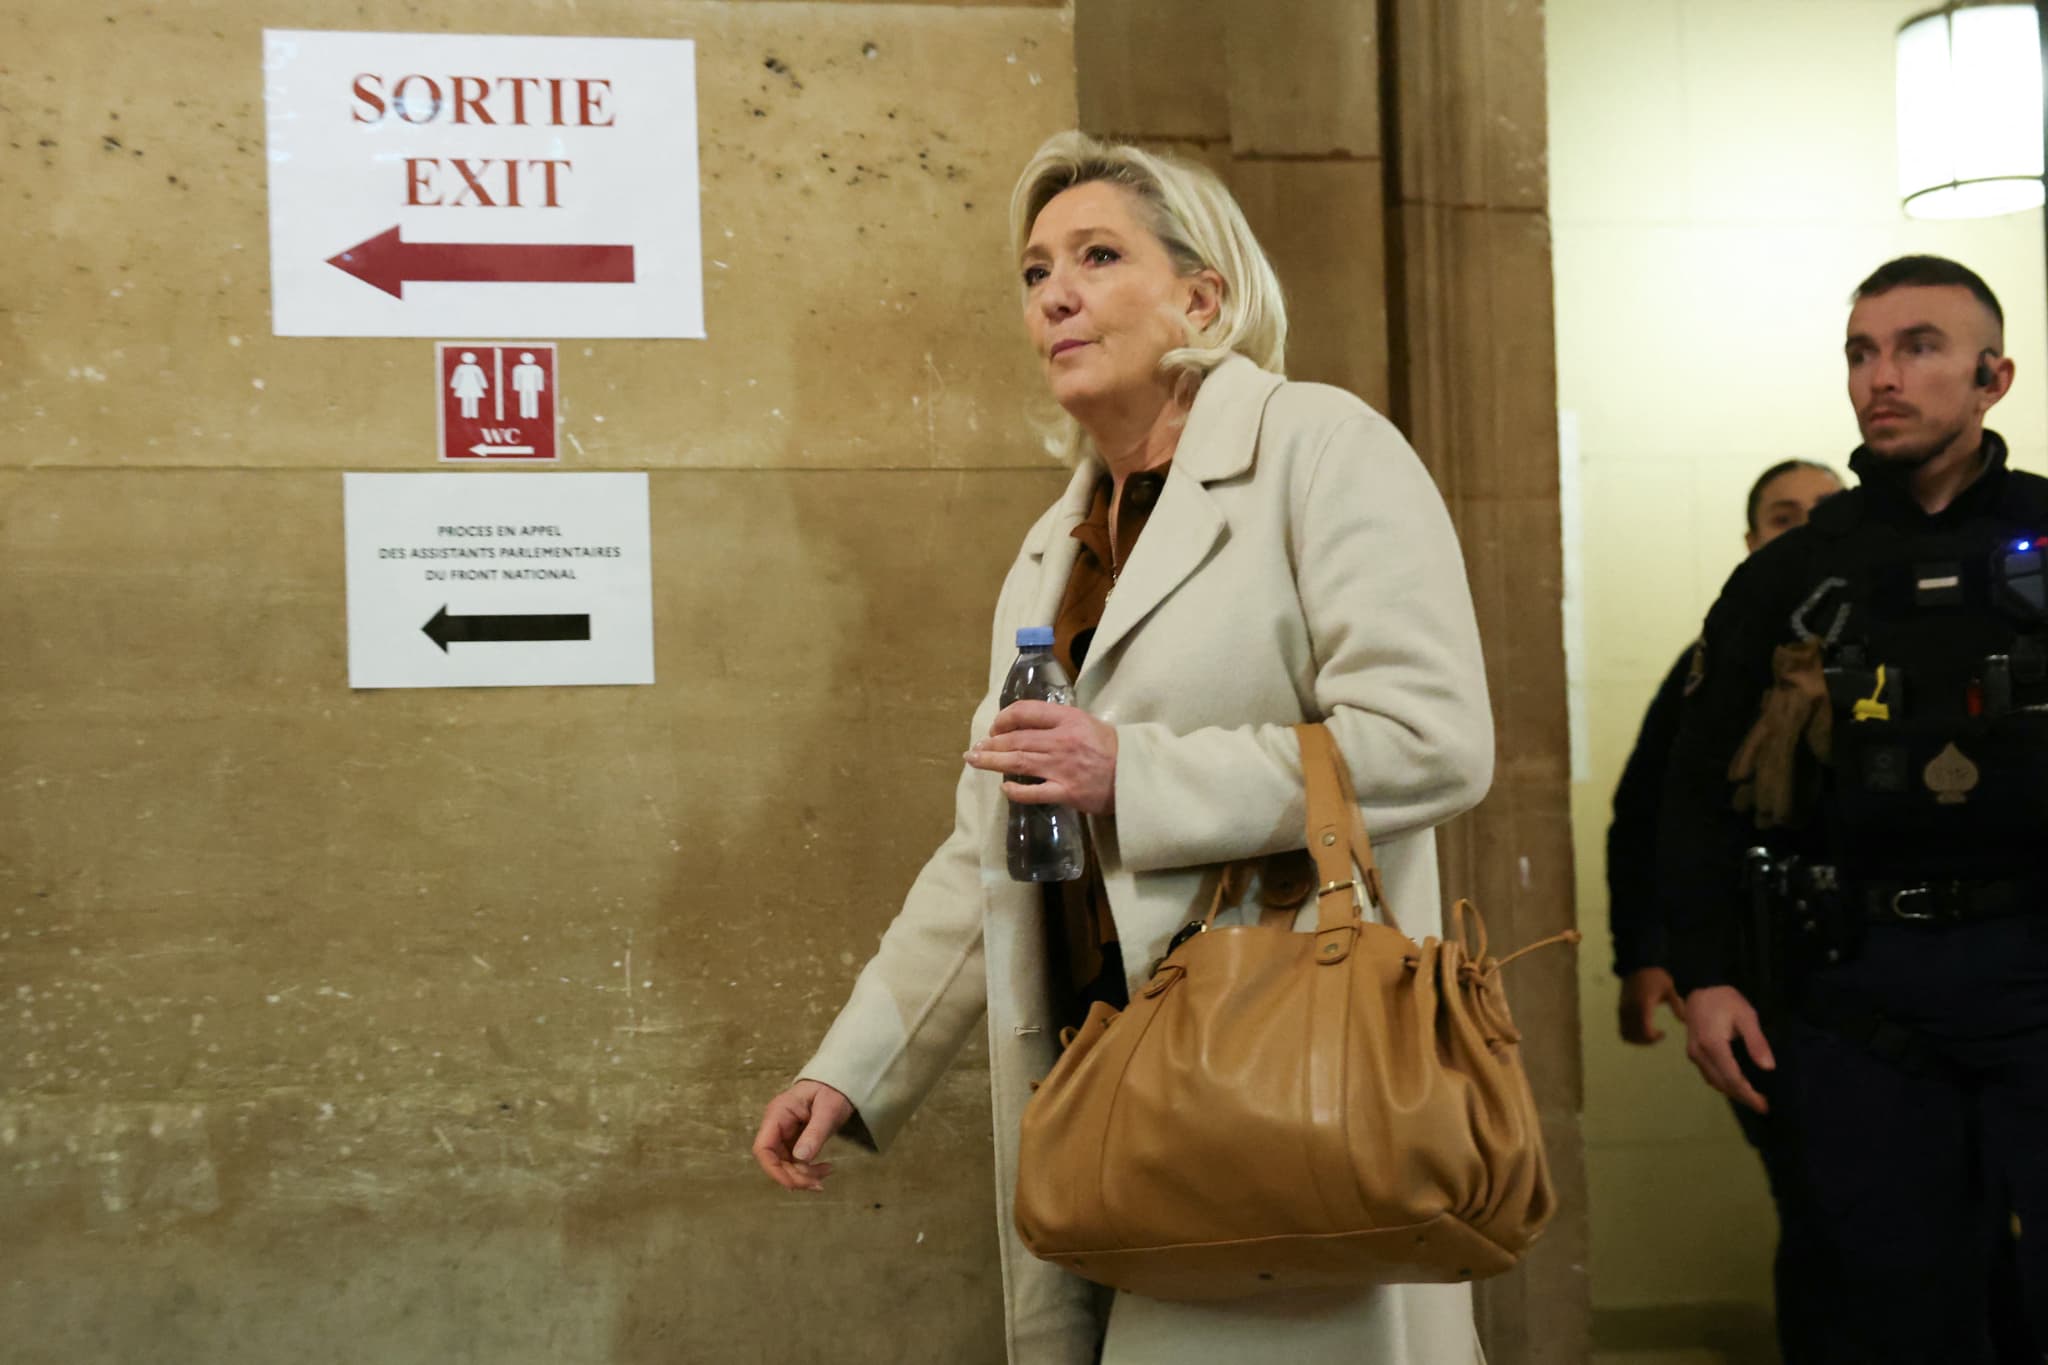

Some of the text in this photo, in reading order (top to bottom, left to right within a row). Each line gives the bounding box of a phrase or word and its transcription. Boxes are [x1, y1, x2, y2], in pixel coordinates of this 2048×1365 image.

[351, 72, 615, 128] SORTIE
[402, 157, 573, 208] EXIT
[480, 427, 521, 445] WC
[438, 525, 562, 537] PROCES EN APPEL
[379, 546, 621, 559] DES ASSISTANTS PARLEMENTAIRES
[425, 568, 576, 581] DU FRONT NATIONAL
